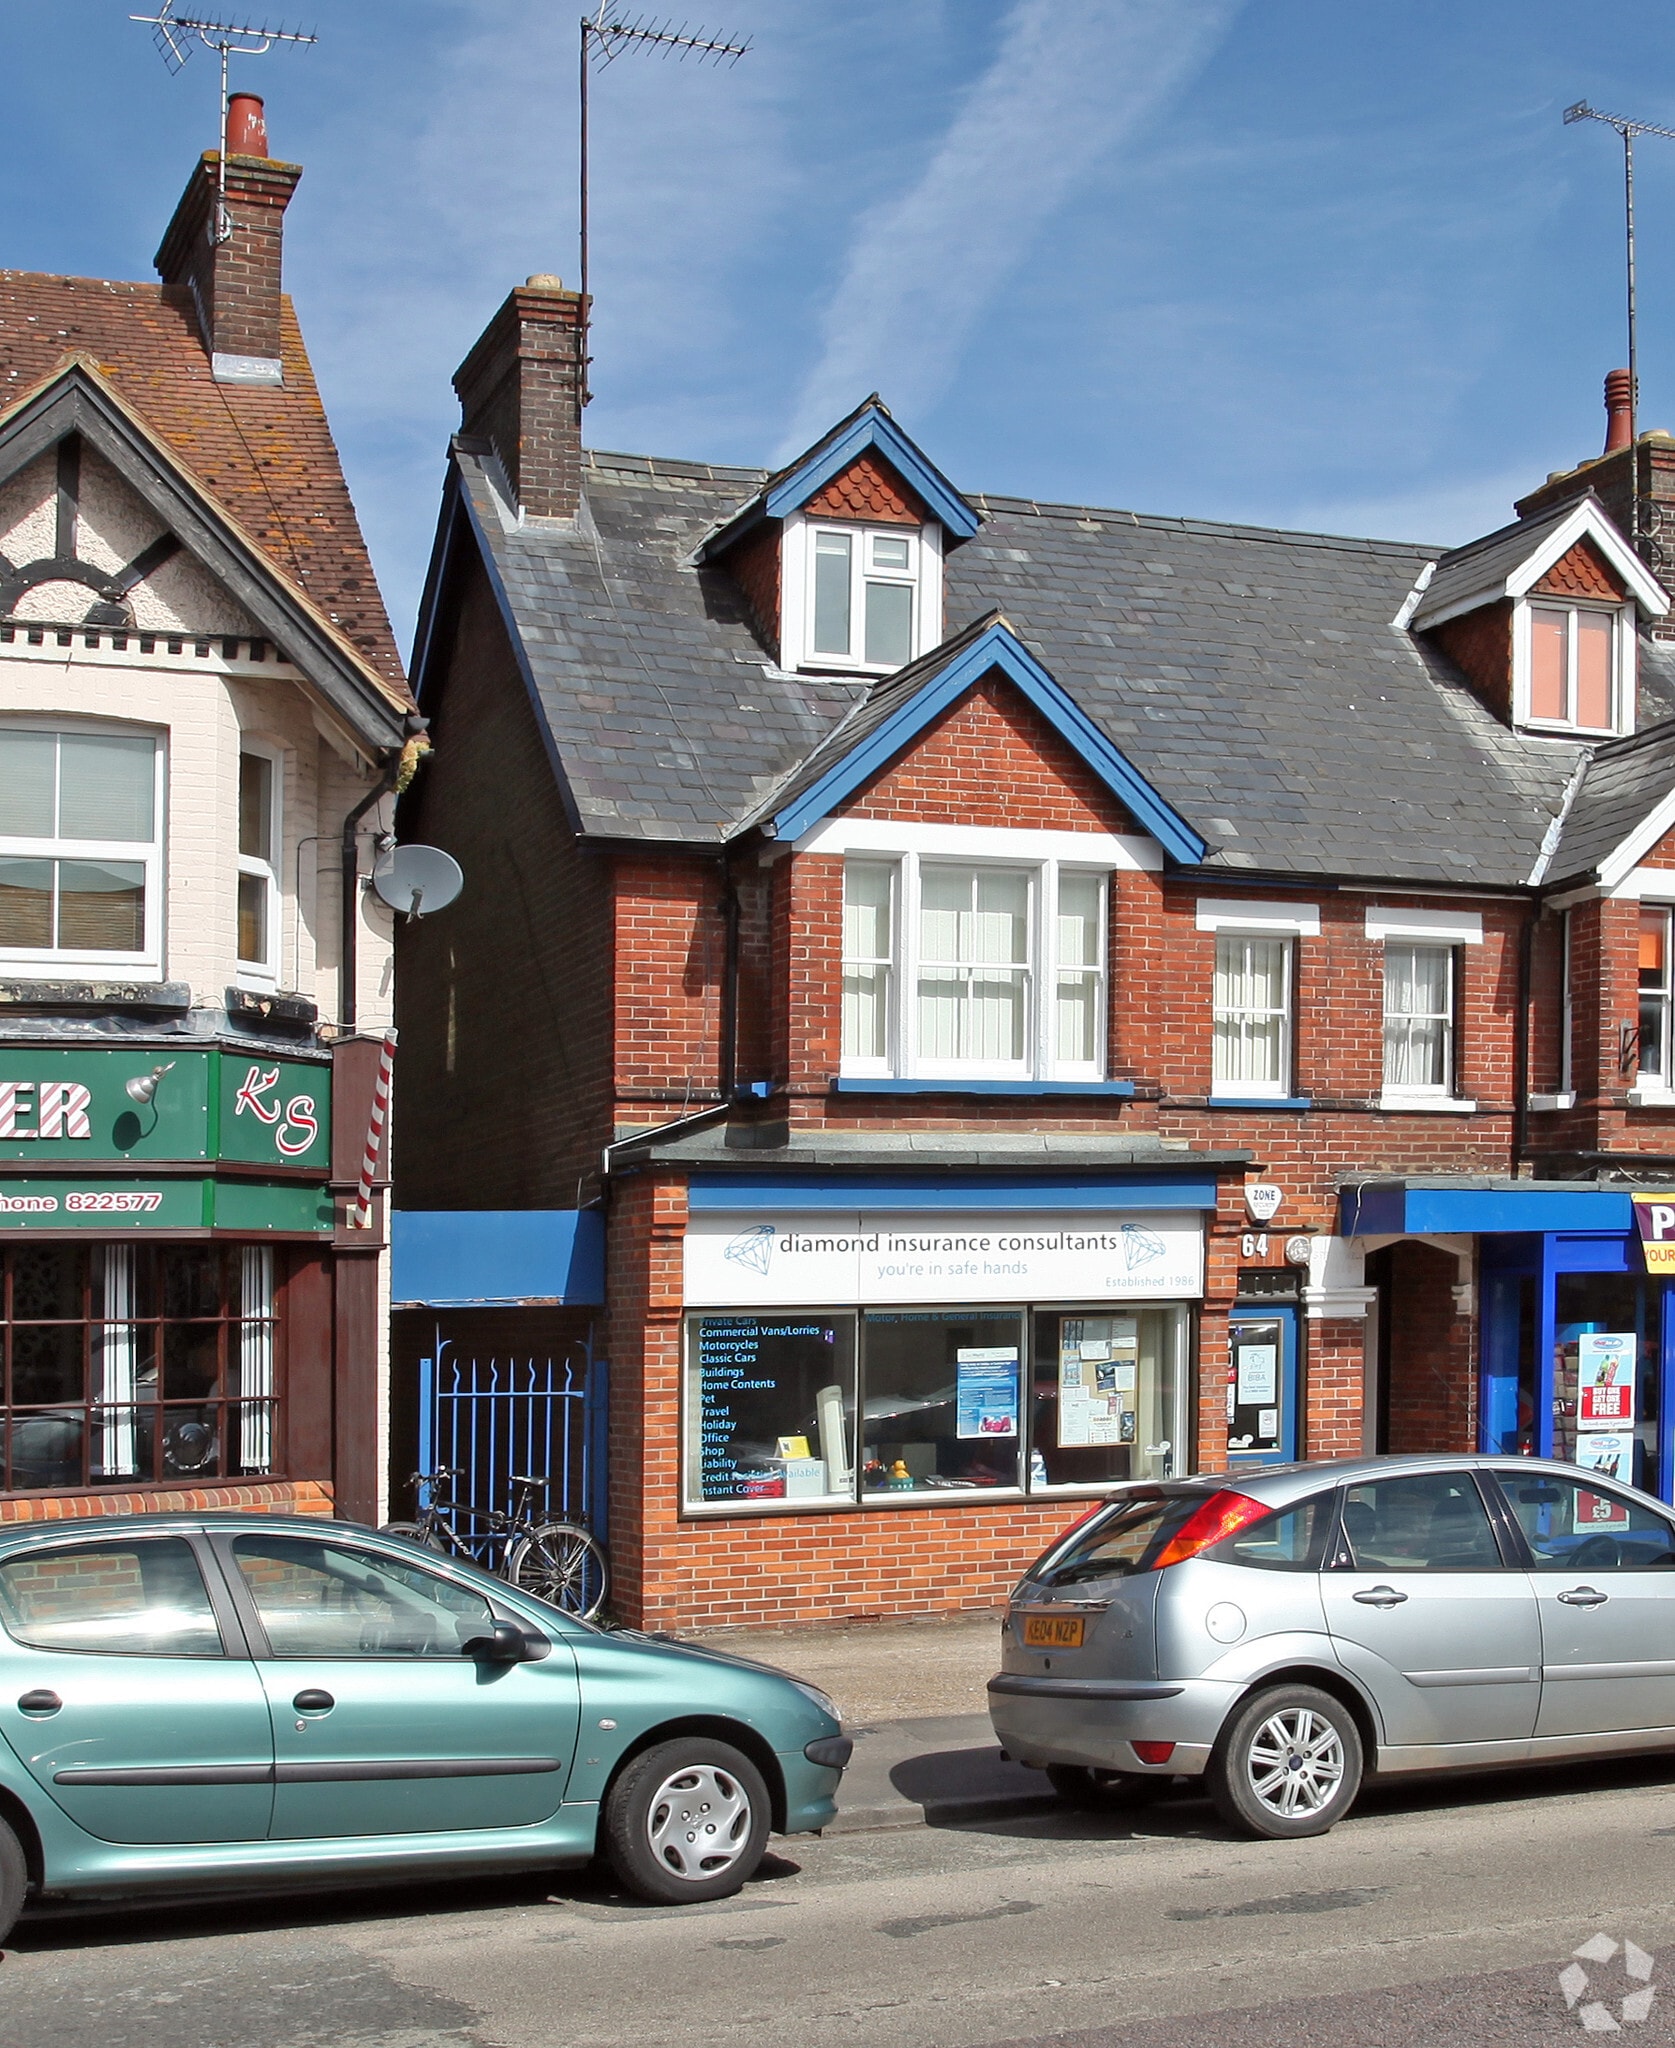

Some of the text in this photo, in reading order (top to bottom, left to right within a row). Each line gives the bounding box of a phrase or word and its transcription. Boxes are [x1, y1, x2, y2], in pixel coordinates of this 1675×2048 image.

[1253, 1190, 1275, 1200] ZONE
[66, 1192, 162, 1212] 822577
[780, 1231, 1117, 1252] diamond insurance consultants
[1242, 1233, 1268, 1257] 64
[877, 1260, 1028, 1279] you're in safe hands
[1105, 1275, 1195, 1287] Established 1986
[736, 1315, 757, 1326] Cars
[699, 1325, 820, 1338] Commercial Vans/Lorries
[699, 1340, 759, 1352] Motorcycles
[699, 1353, 757, 1364] Classic Cars
[699, 1366, 745, 1379] Buildings
[699, 1379, 776, 1391] Home Contents
[699, 1394, 715, 1404] Pet
[699, 1406, 730, 1417] Travel
[1592, 1402, 1620, 1415] FREE
[699, 1419, 737, 1432] Holiday
[699, 1433, 730, 1443] Office
[699, 1446, 725, 1457] Shop
[699, 1459, 738, 1470] Liability
[699, 1472, 729, 1482] Credit
[1029, 1620, 1078, 1642] KE04 NZP
